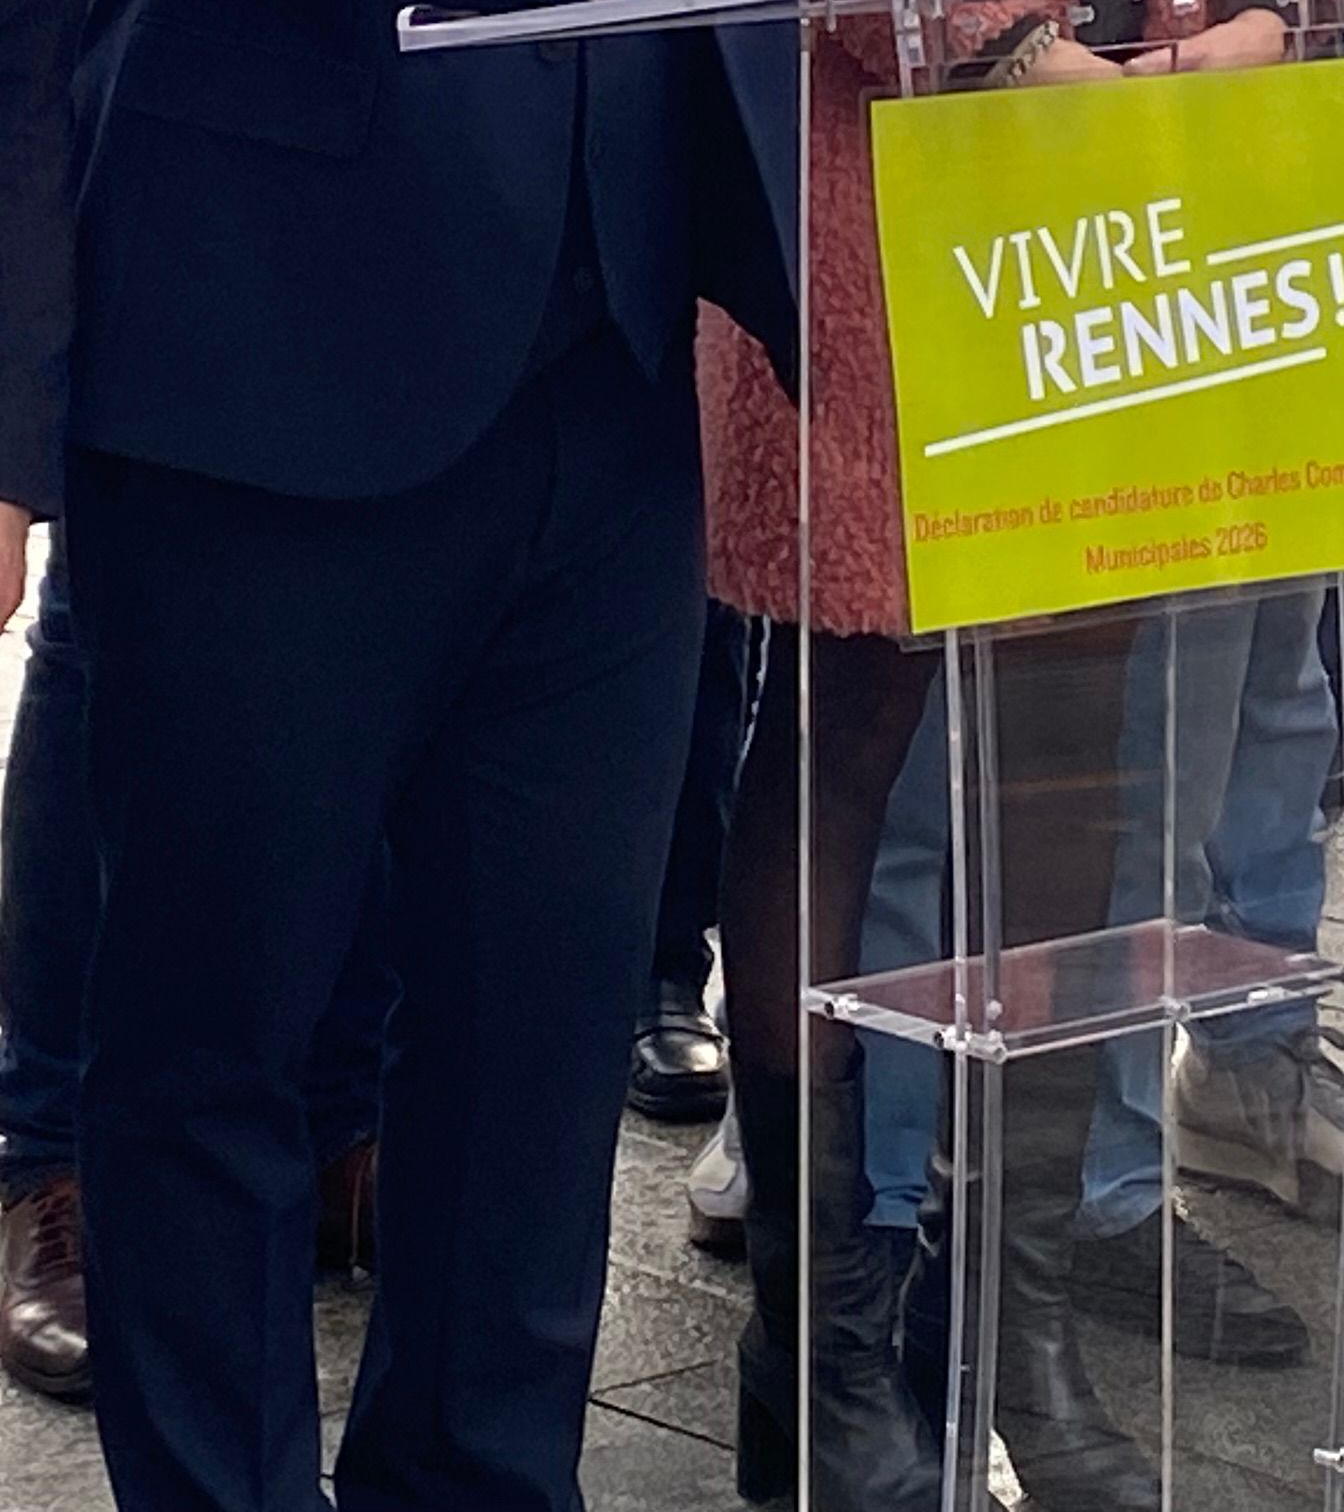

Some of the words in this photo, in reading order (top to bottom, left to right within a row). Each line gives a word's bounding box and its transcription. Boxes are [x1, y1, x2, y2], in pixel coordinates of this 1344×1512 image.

[953, 198, 1191, 319] VIVRE
[914, 508, 1033, 542] Déclaration
[1039, 496, 1063, 525] de
[1070, 486, 1194, 520] candidature
[1198, 473, 1223, 504] de
[1226, 466, 1301, 500] Charles
[1086, 536, 1211, 573] Municipales
[1215, 521, 1268, 557] 2026
